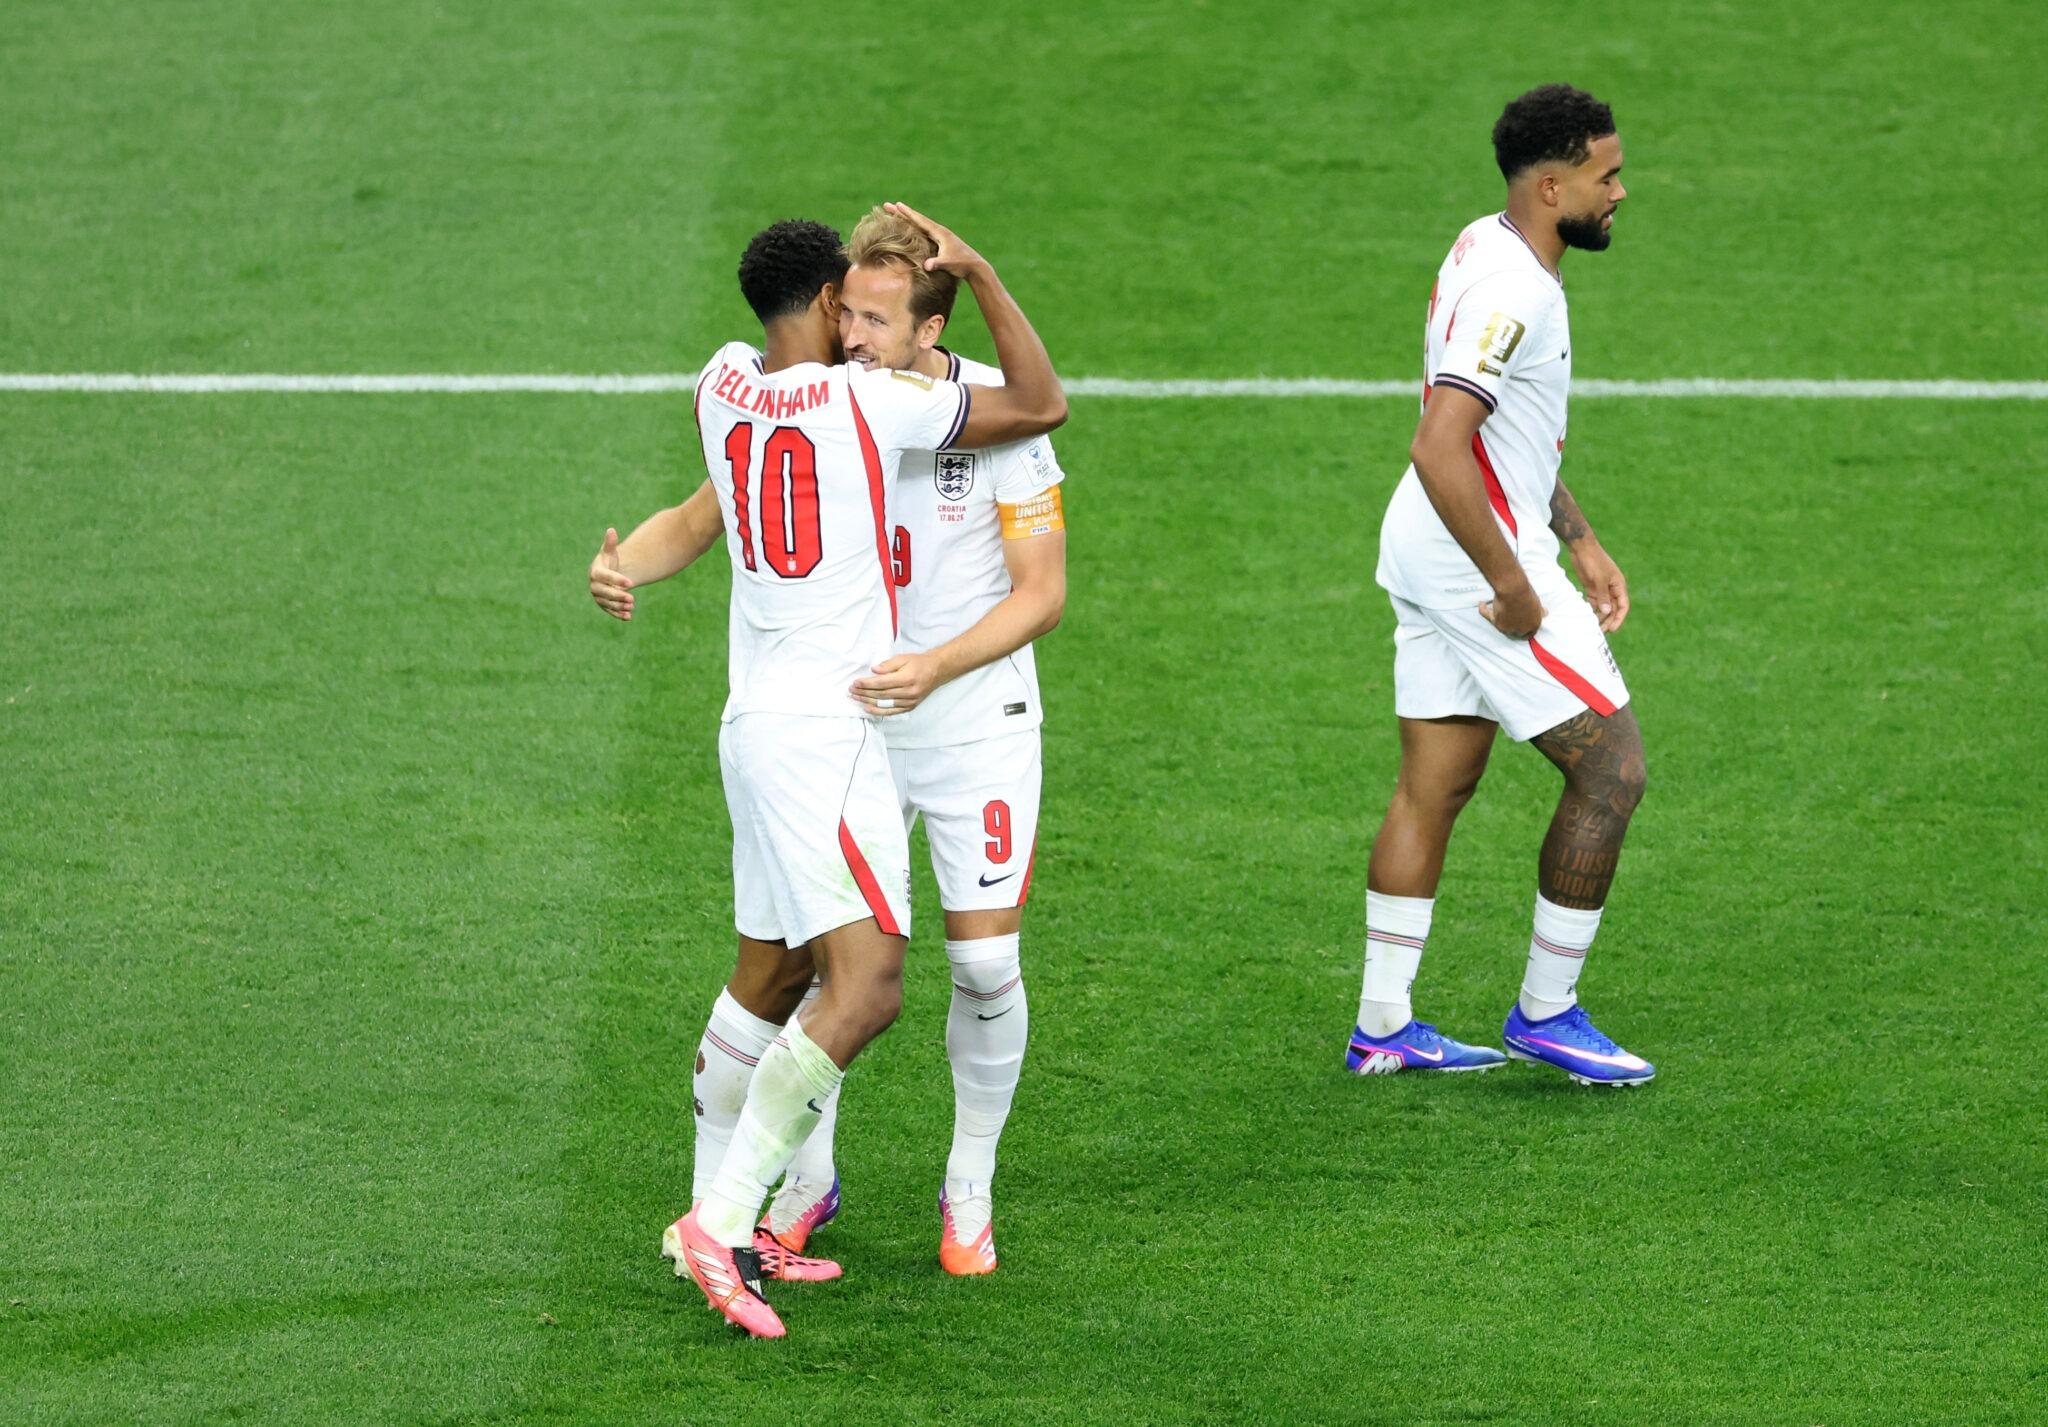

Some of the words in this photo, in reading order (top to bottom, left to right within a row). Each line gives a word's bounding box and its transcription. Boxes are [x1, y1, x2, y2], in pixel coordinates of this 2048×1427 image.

[725, 421, 823, 578] 10
[937, 504, 967, 513] CROATIA
[1015, 501, 1056, 519] UNITES
[892, 525, 912, 588] 9
[982, 799, 1013, 865] 9
